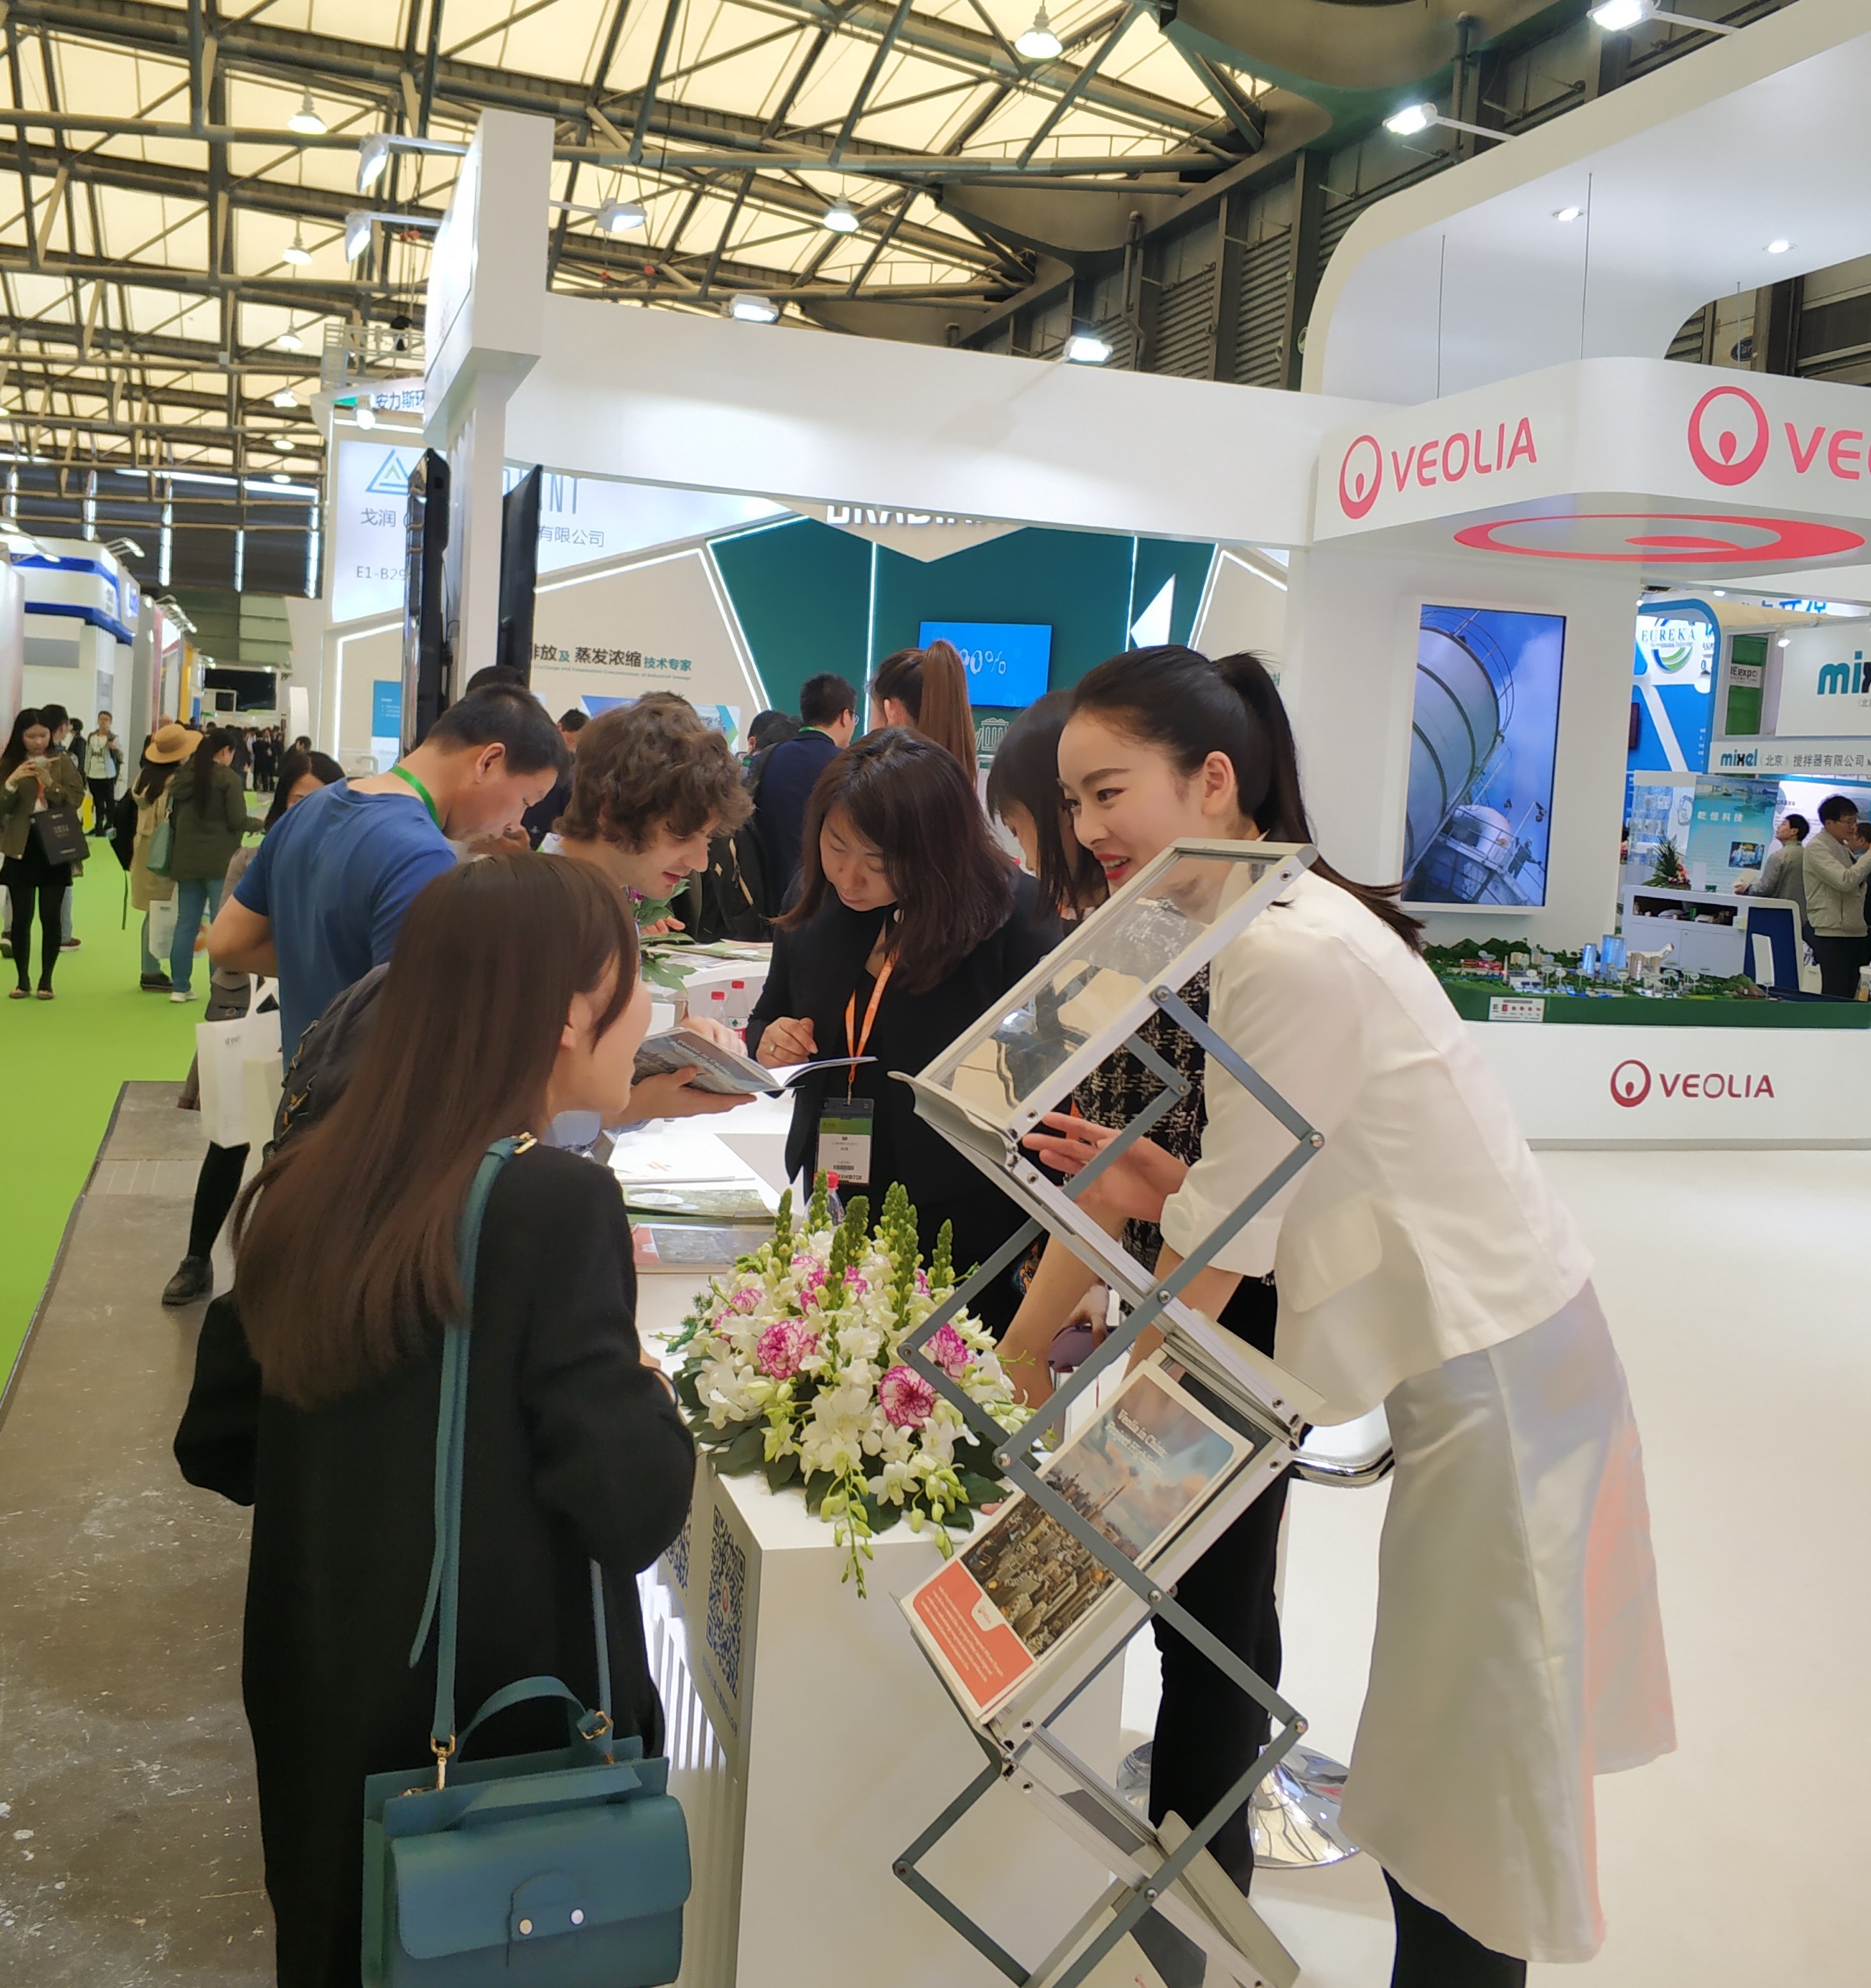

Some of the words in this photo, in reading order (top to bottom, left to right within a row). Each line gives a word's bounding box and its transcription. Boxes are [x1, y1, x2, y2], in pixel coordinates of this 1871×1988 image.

[1390, 416, 1537, 492] VEOLIA
[1784, 422, 1871, 479] VE
[360, 508, 397, 527] 戈润
[540, 525, 605, 547] 有限公司
[1641, 628, 1696, 642] EUREKA
[1720, 749, 1758, 766] mixel
[1660, 1073, 1775, 1099] VEOLIA
